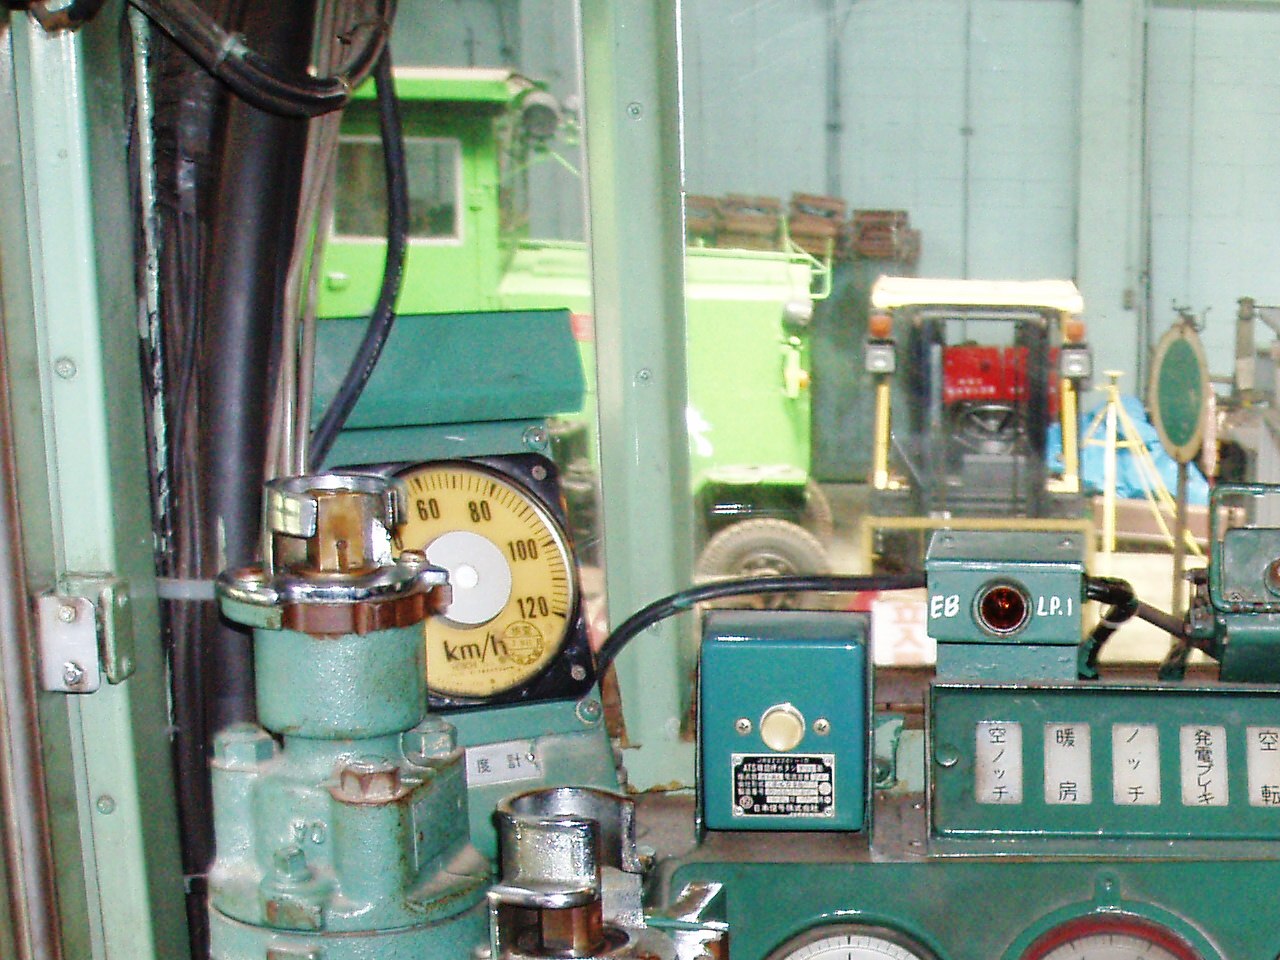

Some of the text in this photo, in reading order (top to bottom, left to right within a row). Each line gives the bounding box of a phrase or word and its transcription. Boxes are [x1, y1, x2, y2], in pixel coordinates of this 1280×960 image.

[417, 498, 440, 521] 60
[468, 500, 491, 522] 80
[507, 538, 538, 561] 100
[517, 596, 548, 619] 120
[930, 595, 960, 619] EB
[443, 632, 507, 662] km/h
[988, 727, 1008, 802] 空ノッチ
[1056, 728, 1077, 801] 暖房
[1126, 728, 1144, 802] ノッチ
[1258, 731, 1280, 805] 空転
